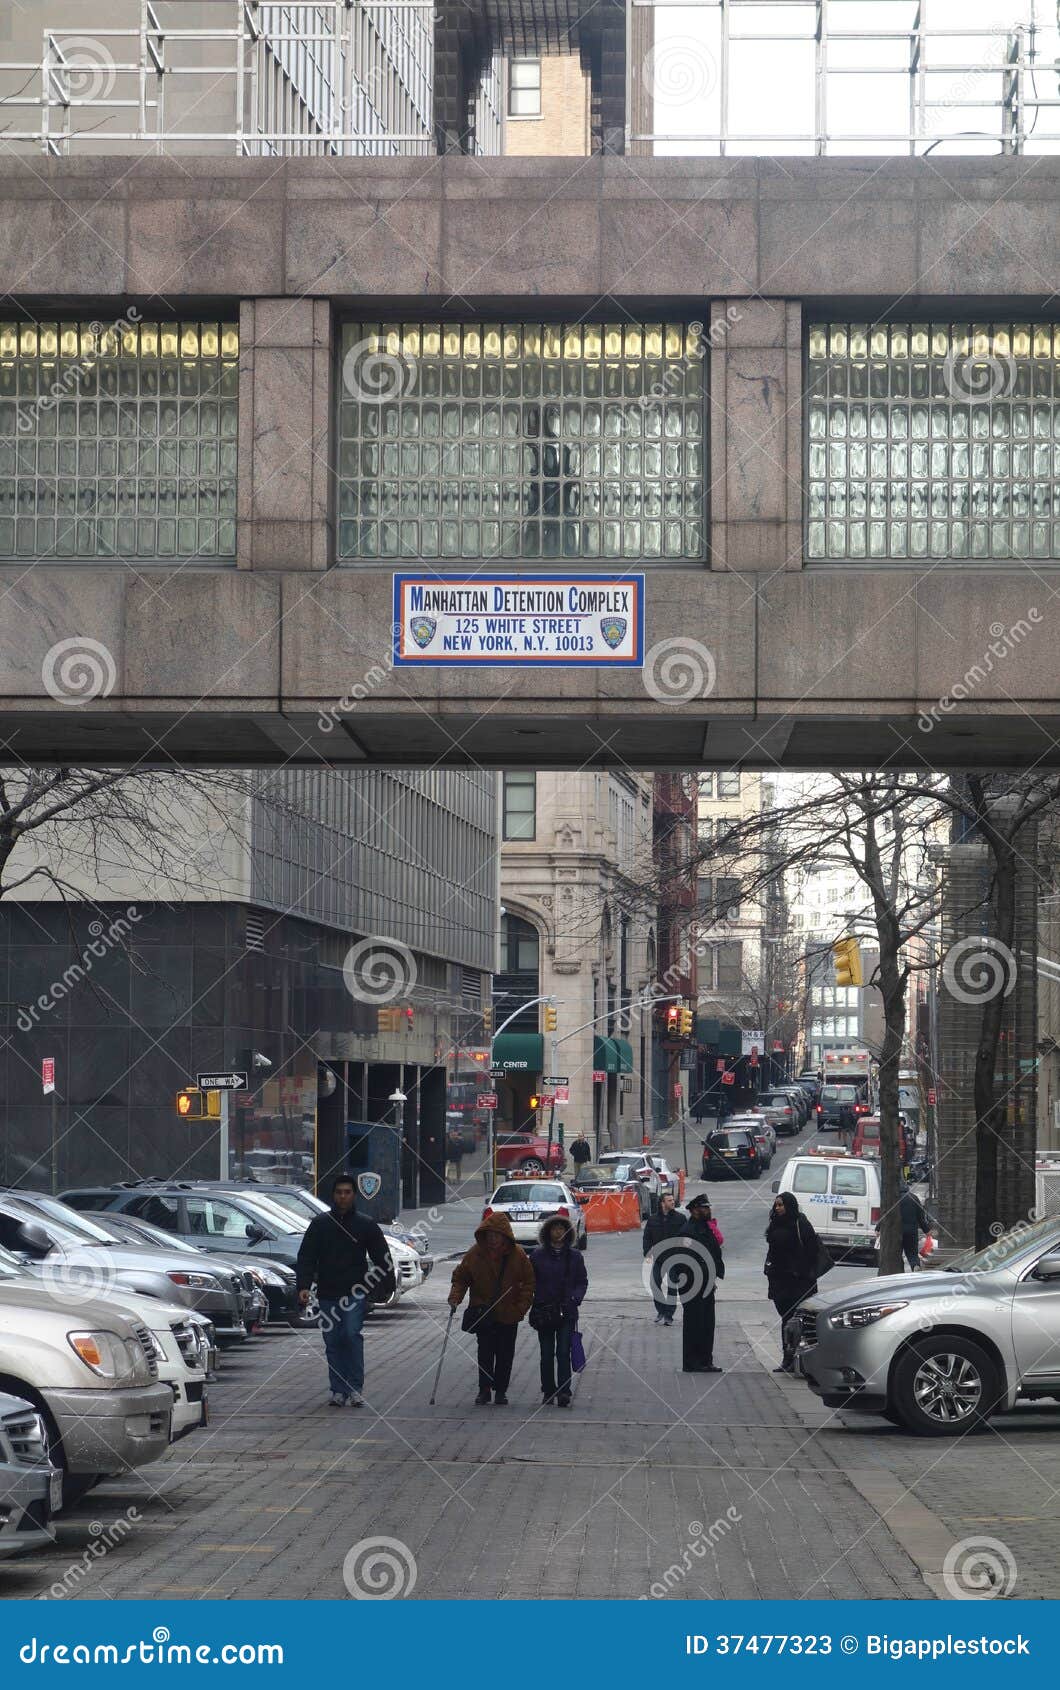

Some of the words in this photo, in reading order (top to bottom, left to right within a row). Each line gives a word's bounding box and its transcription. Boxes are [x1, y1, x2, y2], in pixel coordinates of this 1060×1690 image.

[410, 586, 488, 612] MANHATTAN
[494, 586, 564, 612] DETENTION
[568, 586, 629, 612] COMPLEX
[455, 618, 479, 634] 125
[486, 618, 526, 634] WHITE
[533, 618, 581, 634] STREET
[443, 635, 472, 651] NEW
[479, 635, 518, 653] YORK,
[524, 635, 549, 651] N.Y.
[555, 635, 594, 651] 10013
[204, 1078, 218, 1086] ONE
